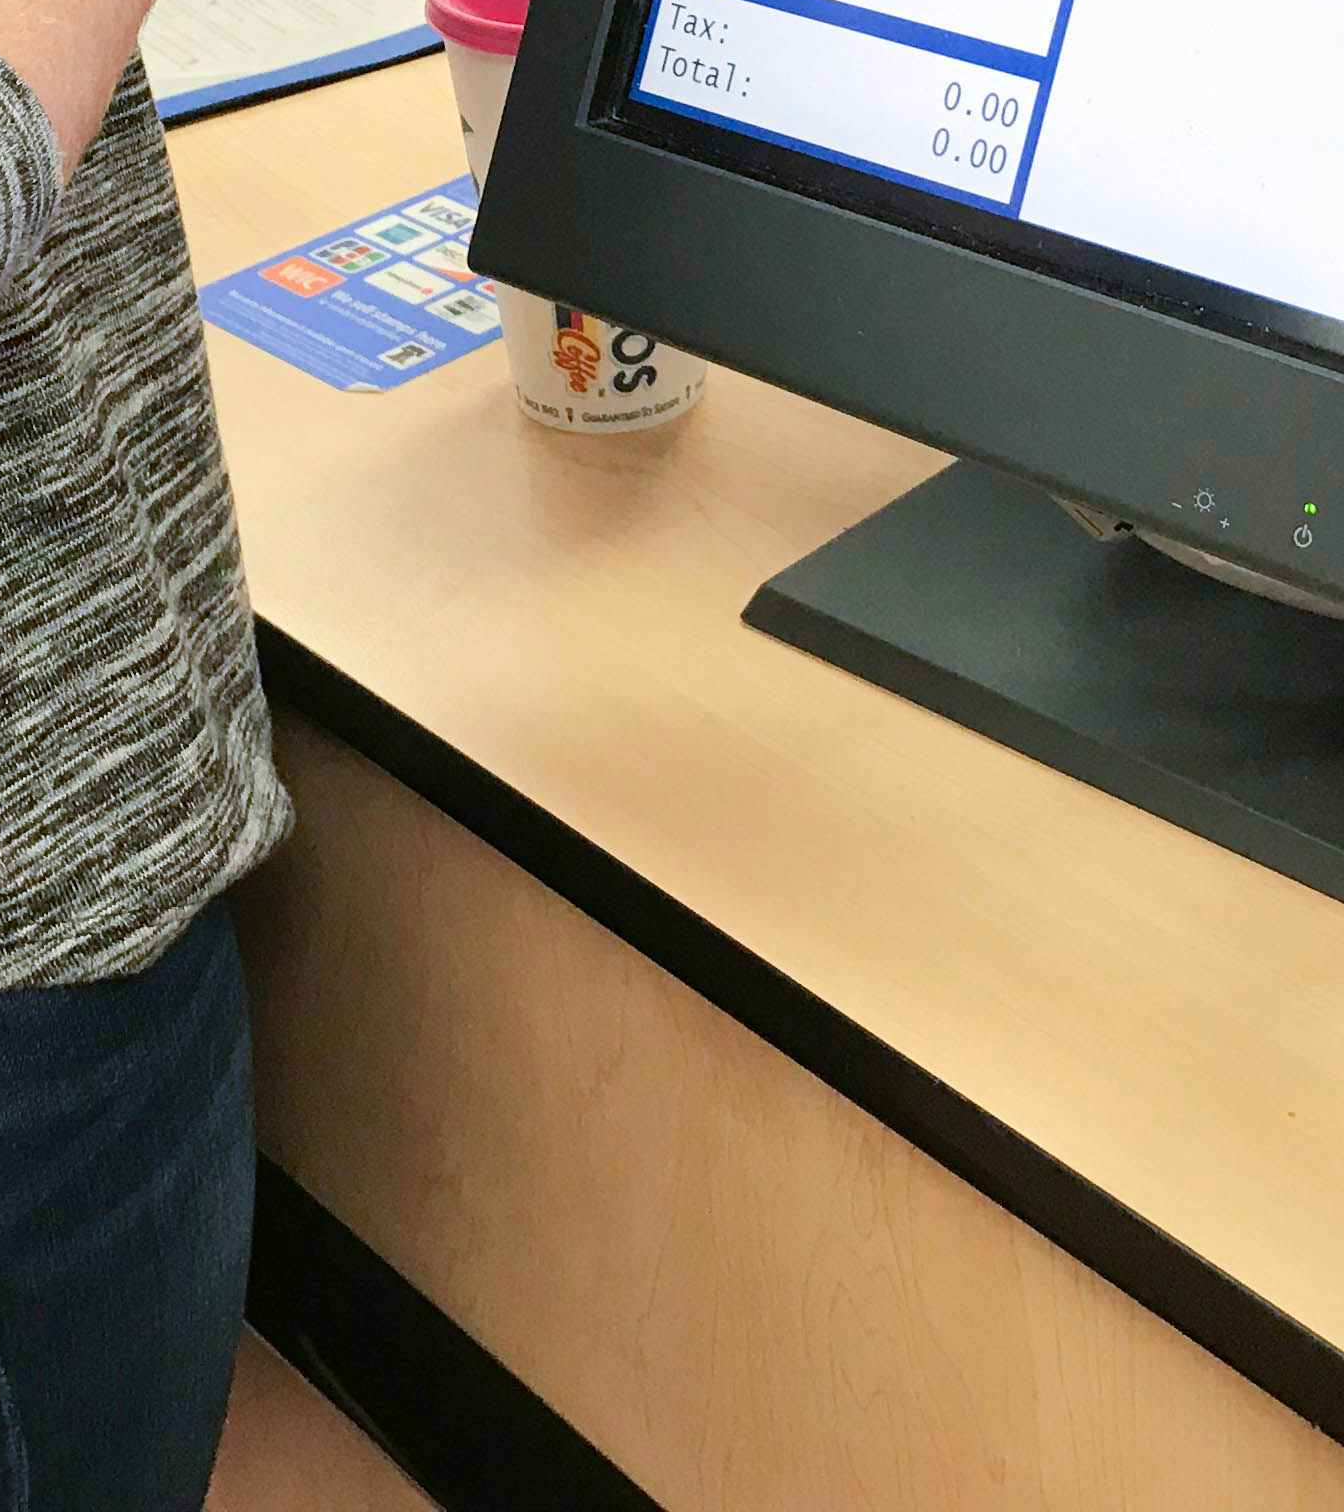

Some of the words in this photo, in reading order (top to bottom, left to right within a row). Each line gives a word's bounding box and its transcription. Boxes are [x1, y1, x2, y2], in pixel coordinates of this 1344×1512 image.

[670, 2, 730, 44] Tax:
[944, 81, 1019, 128] 0.00
[659, 45, 752, 98] Total:
[932, 127, 1007, 174] 0.00
[279, 264, 329, 289] WIC
[552, 327, 601, 393] Coffee
[611, 322, 658, 394] OS
